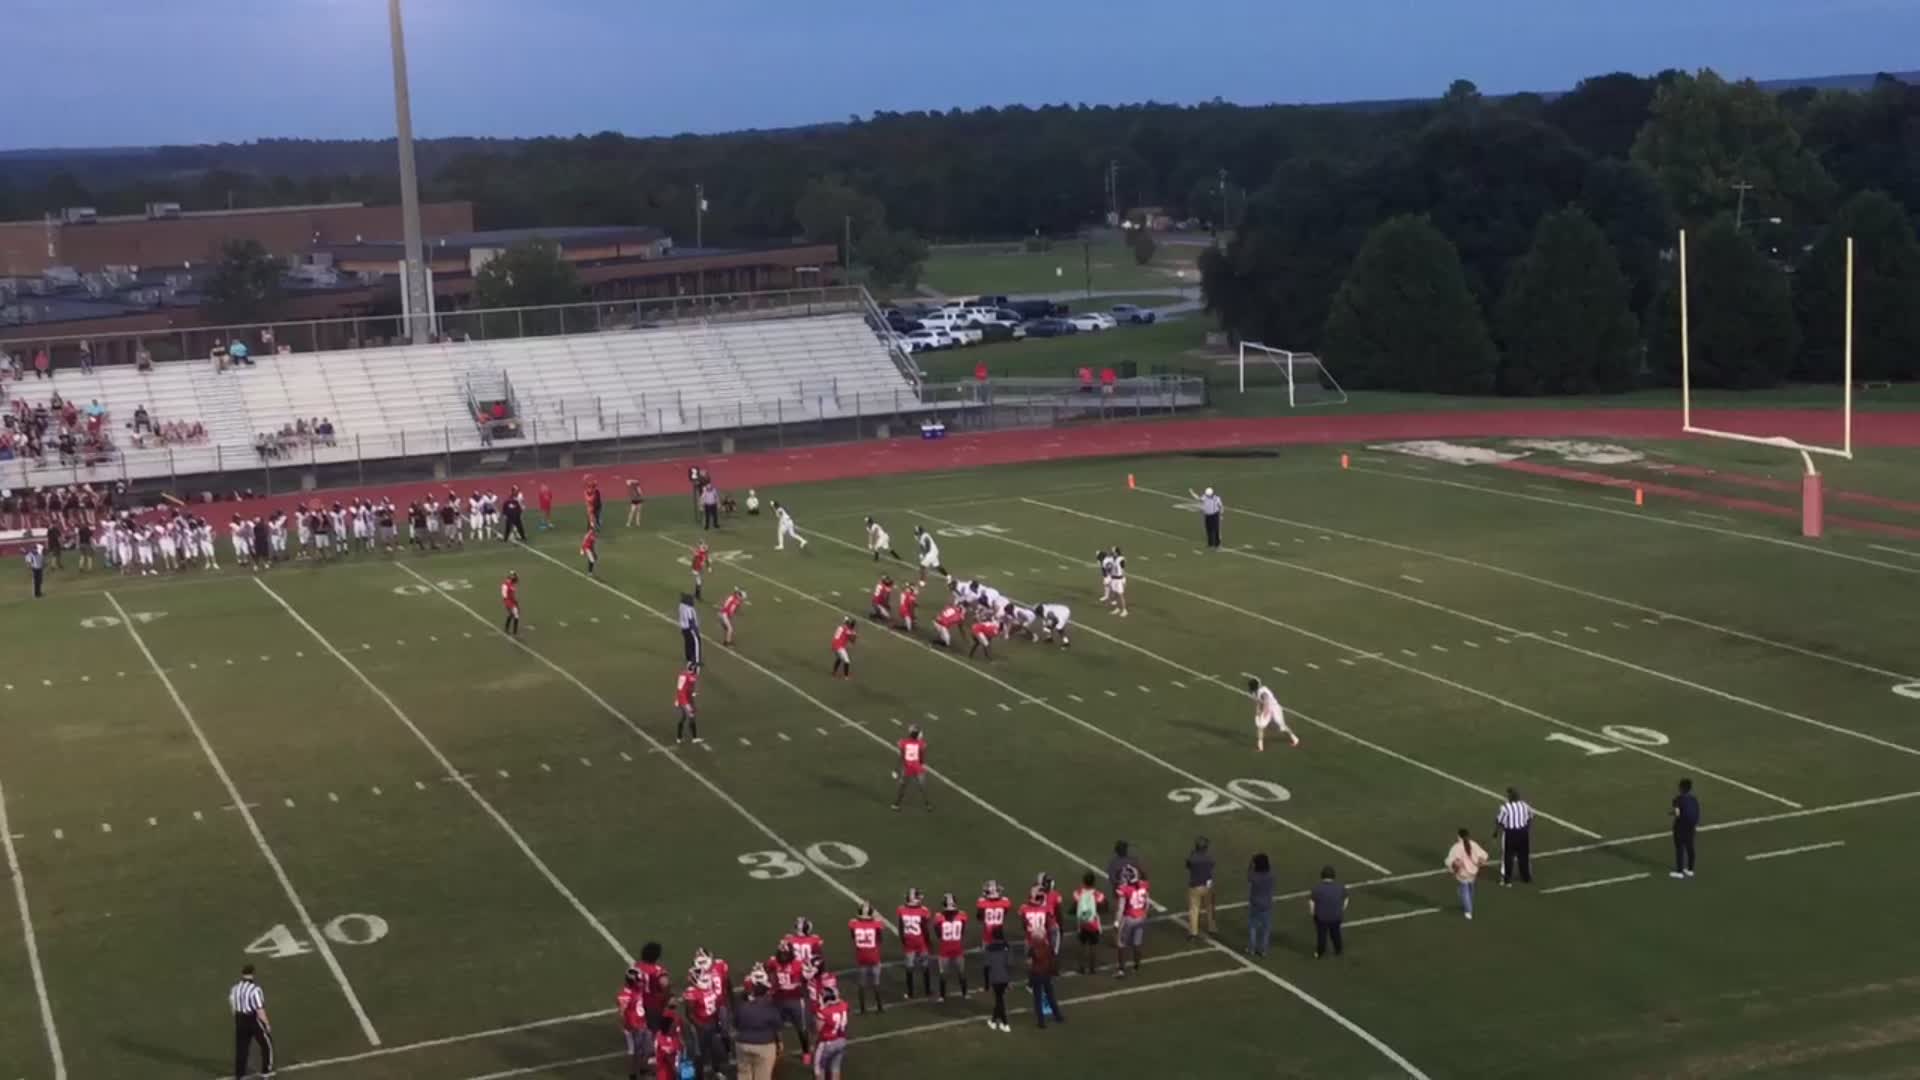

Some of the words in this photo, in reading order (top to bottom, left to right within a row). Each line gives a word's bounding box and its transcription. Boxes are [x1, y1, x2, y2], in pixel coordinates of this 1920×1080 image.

[1544, 724, 1670, 756] 10
[1167, 778, 1291, 815] 20
[737, 841, 869, 880] 30
[243, 913, 390, 958] 40
